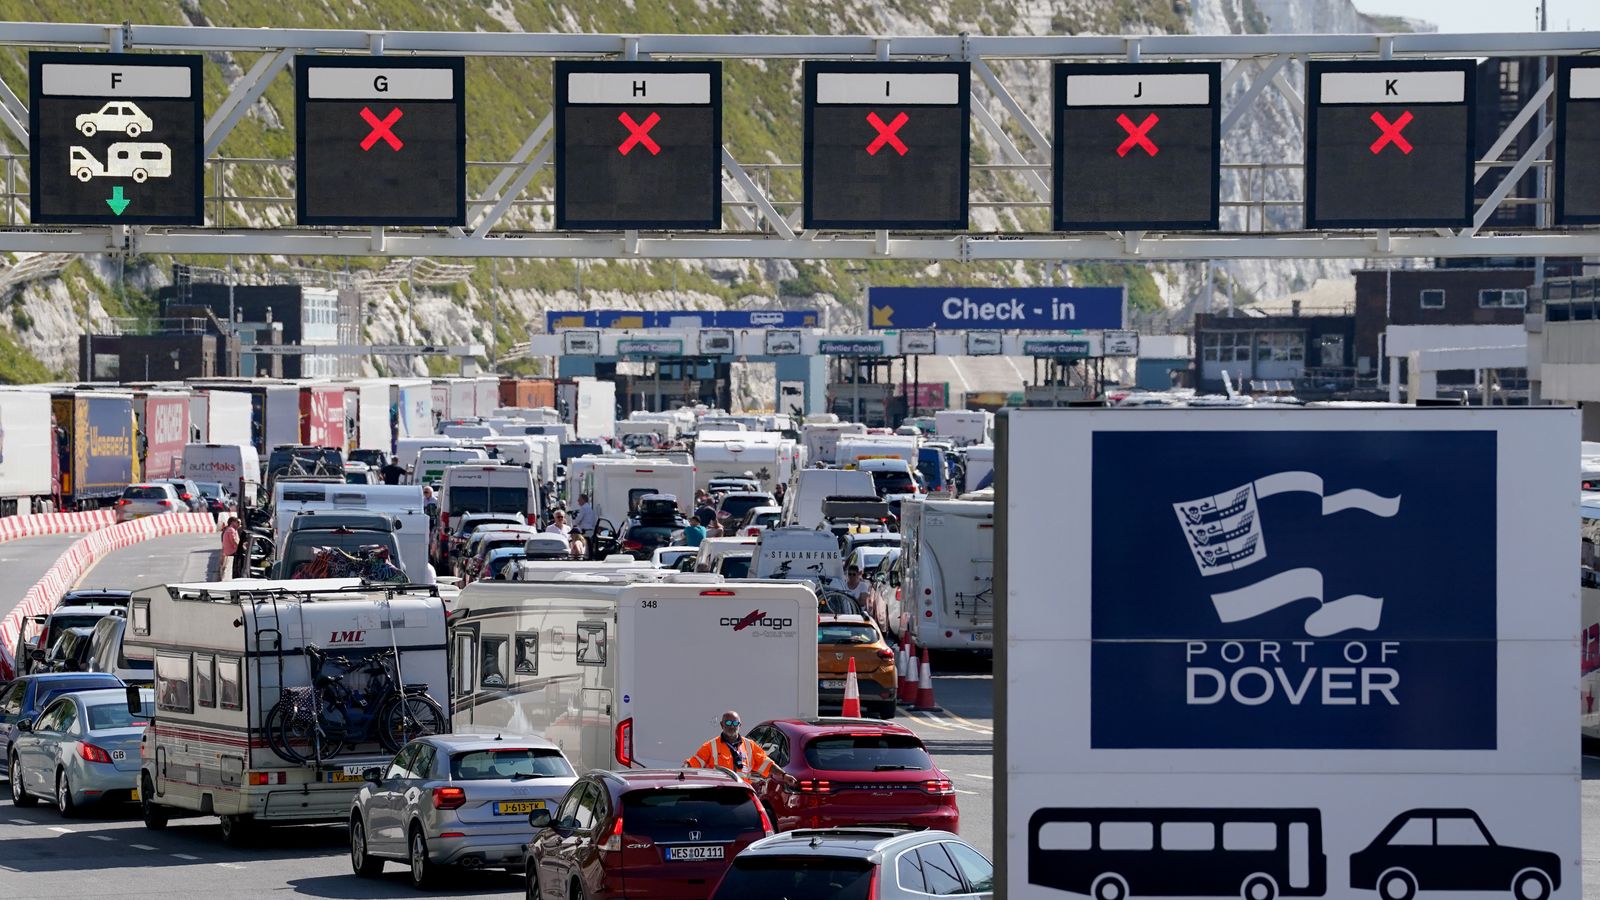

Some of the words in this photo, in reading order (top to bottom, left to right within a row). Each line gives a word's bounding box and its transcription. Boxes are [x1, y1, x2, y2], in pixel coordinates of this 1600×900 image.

[111, 72, 123, 90] F
[373, 75, 389, 93] G
[632, 80, 647, 97] H
[885, 80, 891, 97] I
[1385, 79, 1399, 96] K
[1132, 82, 1143, 99] J
[942, 297, 1025, 321] Check
[1051, 297, 1076, 321] in
[821, 343, 851, 352] Frontier
[853, 343, 881, 353] Control
[1027, 344, 1056, 353] Frontier
[1059, 344, 1088, 353] Control
[189, 461, 236, 472] autoMaks
[771, 550, 838, 560] STAUANFANG
[641, 600, 658, 609] 348
[719, 615, 793, 631] cahago
[328, 630, 367, 643] LMC
[1186, 641, 1315, 663] PORT
[1343, 641, 1400, 663] OF
[1186, 666, 1400, 706] DOVER
[112, 750, 125, 760] GB
[504, 803, 540, 812] J-613-TK
[670, 848, 688, 859] WES
[694, 847, 706, 858] OZ
[706, 847, 723, 858] 111
